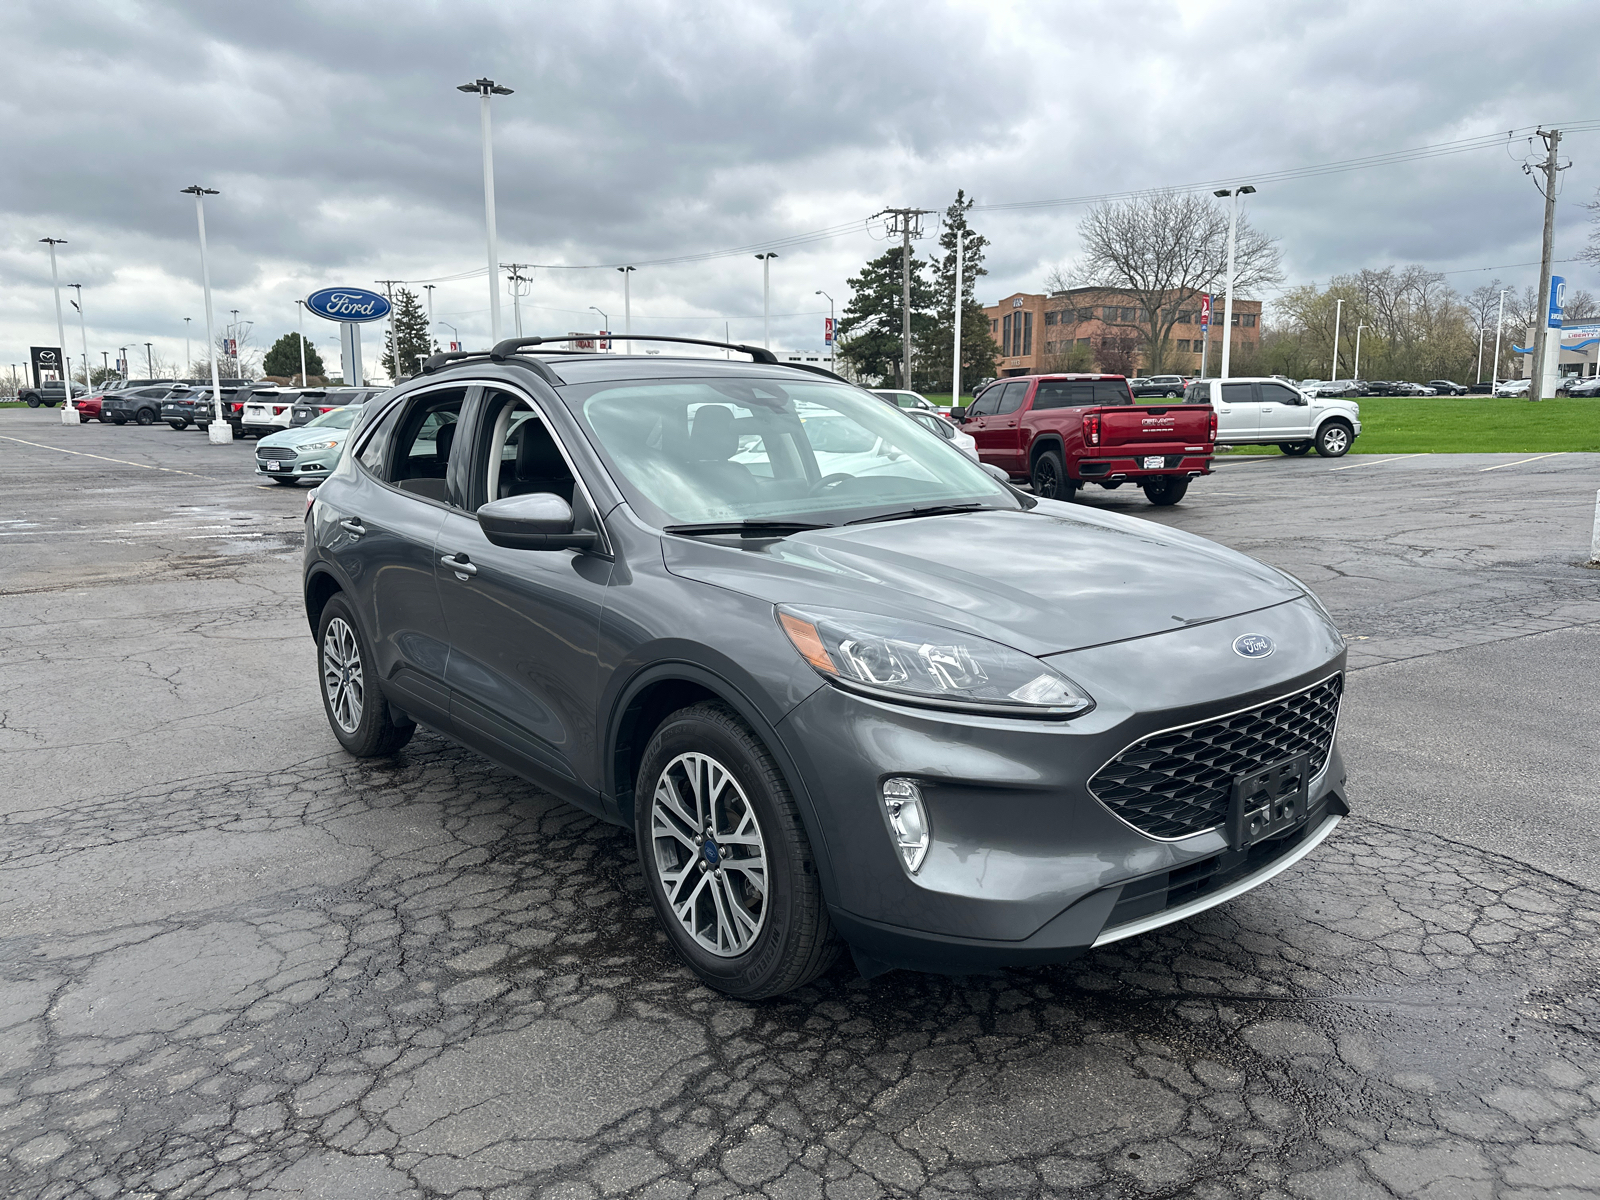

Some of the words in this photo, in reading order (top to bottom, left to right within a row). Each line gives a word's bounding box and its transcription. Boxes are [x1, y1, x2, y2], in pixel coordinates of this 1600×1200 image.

[326, 292, 375, 315] Ford
[1141, 418, 1175, 426] GMC
[1243, 637, 1268, 653] Ford
[749, 927, 781, 981] MICHELIN
